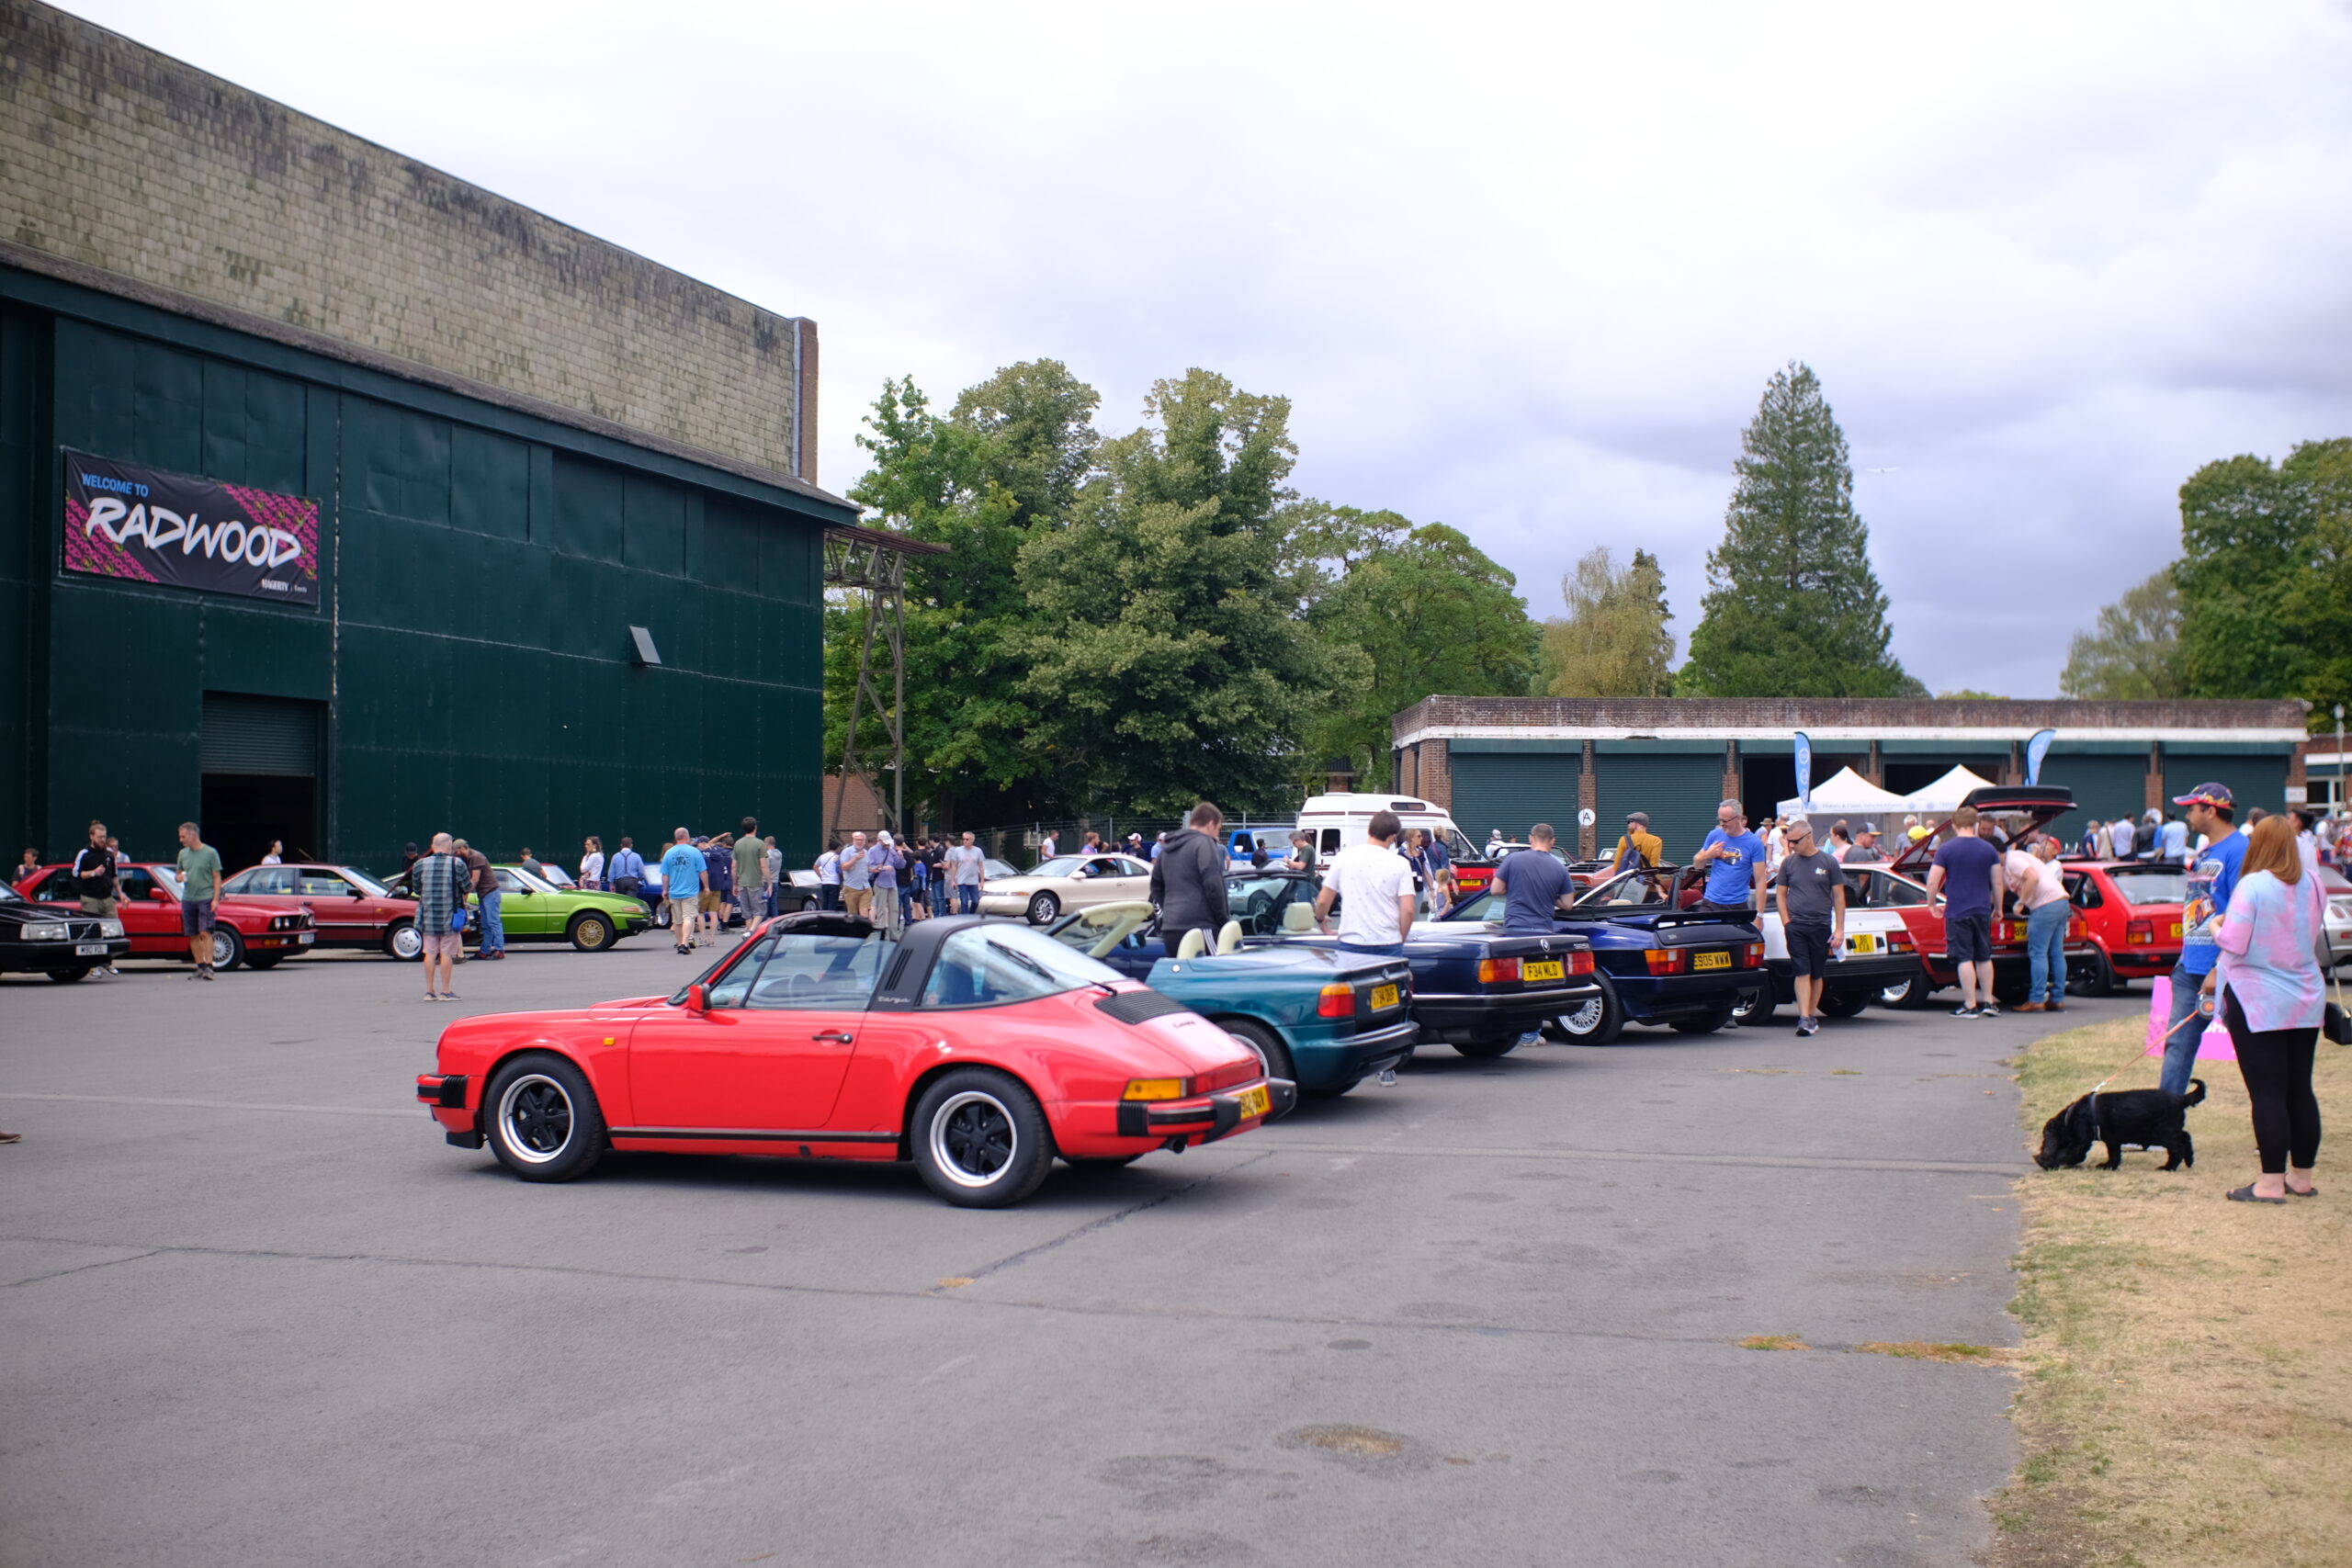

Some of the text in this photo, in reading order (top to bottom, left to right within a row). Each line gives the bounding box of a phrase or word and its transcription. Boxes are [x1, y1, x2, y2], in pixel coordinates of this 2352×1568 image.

[82, 472, 149, 498] WELCOME TO
[85, 497, 301, 568] RADWOOD
[1583, 812, 1591, 822] A
[1527, 964, 1543, 978] F34
